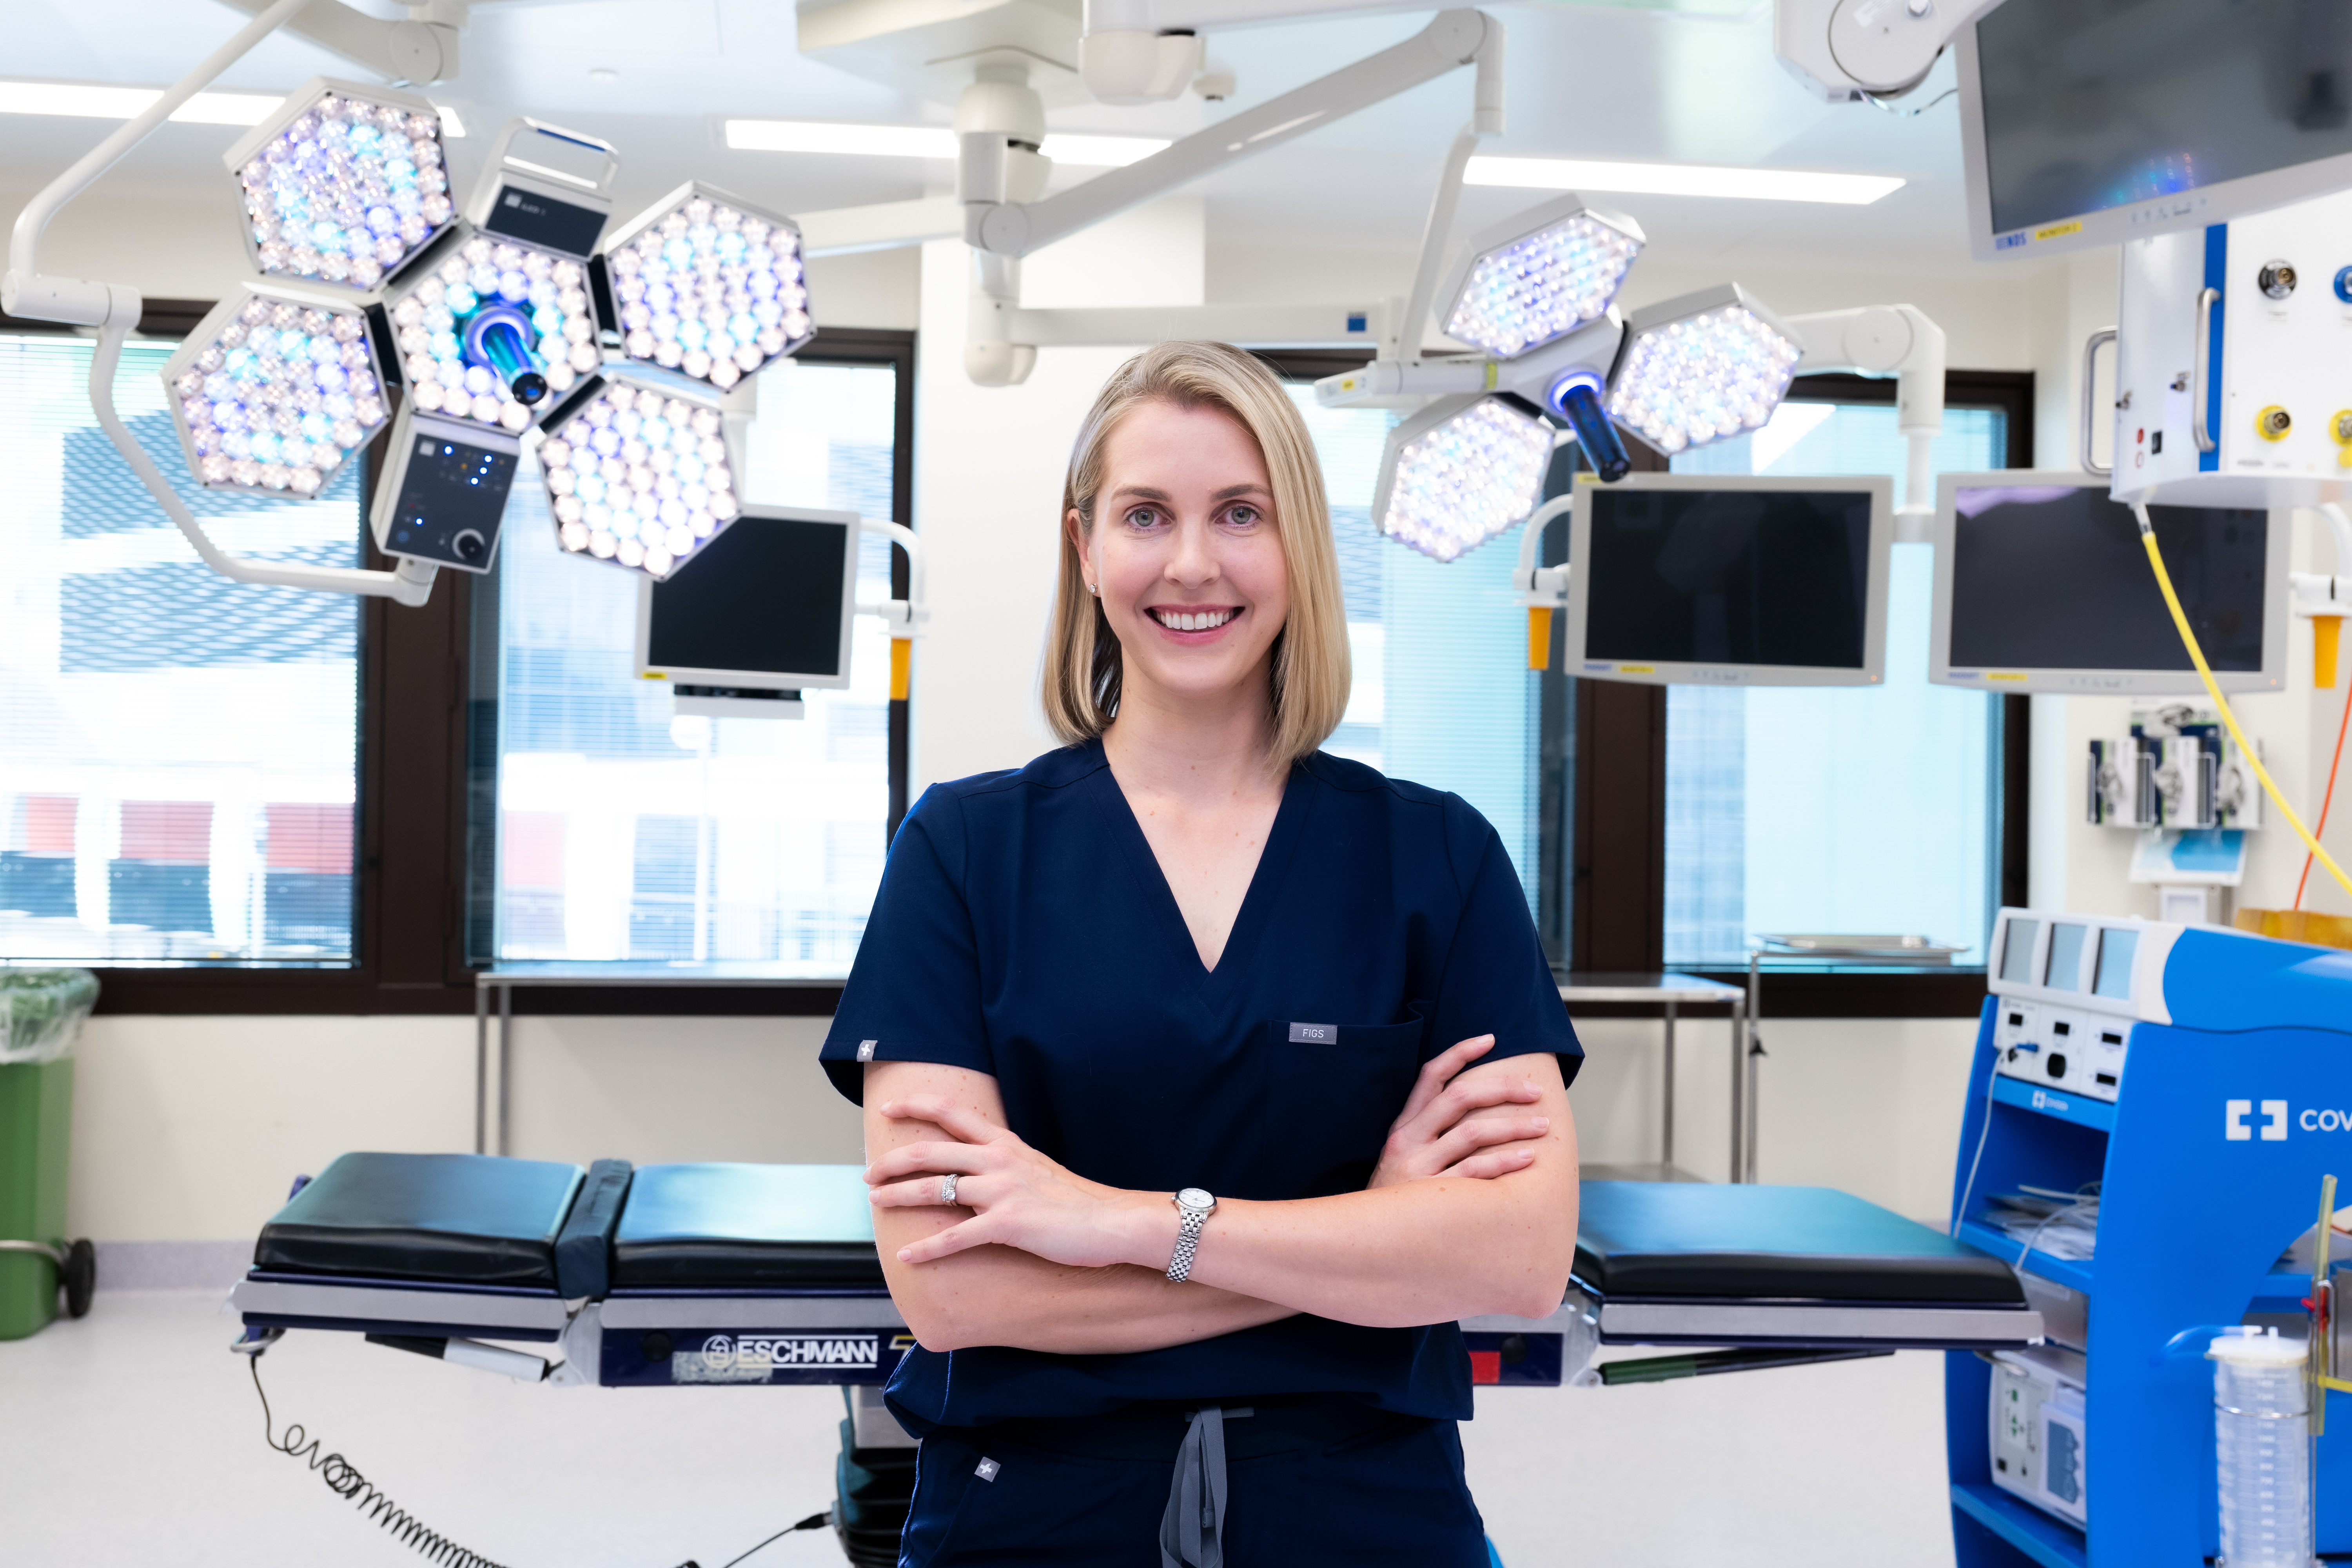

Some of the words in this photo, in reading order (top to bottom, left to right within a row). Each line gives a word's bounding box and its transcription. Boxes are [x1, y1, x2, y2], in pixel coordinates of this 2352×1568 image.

[1303, 1029, 1324, 1038] FIGS
[2299, 1109, 2352, 1132] COV
[737, 1340, 878, 1363] ESCHMANN
